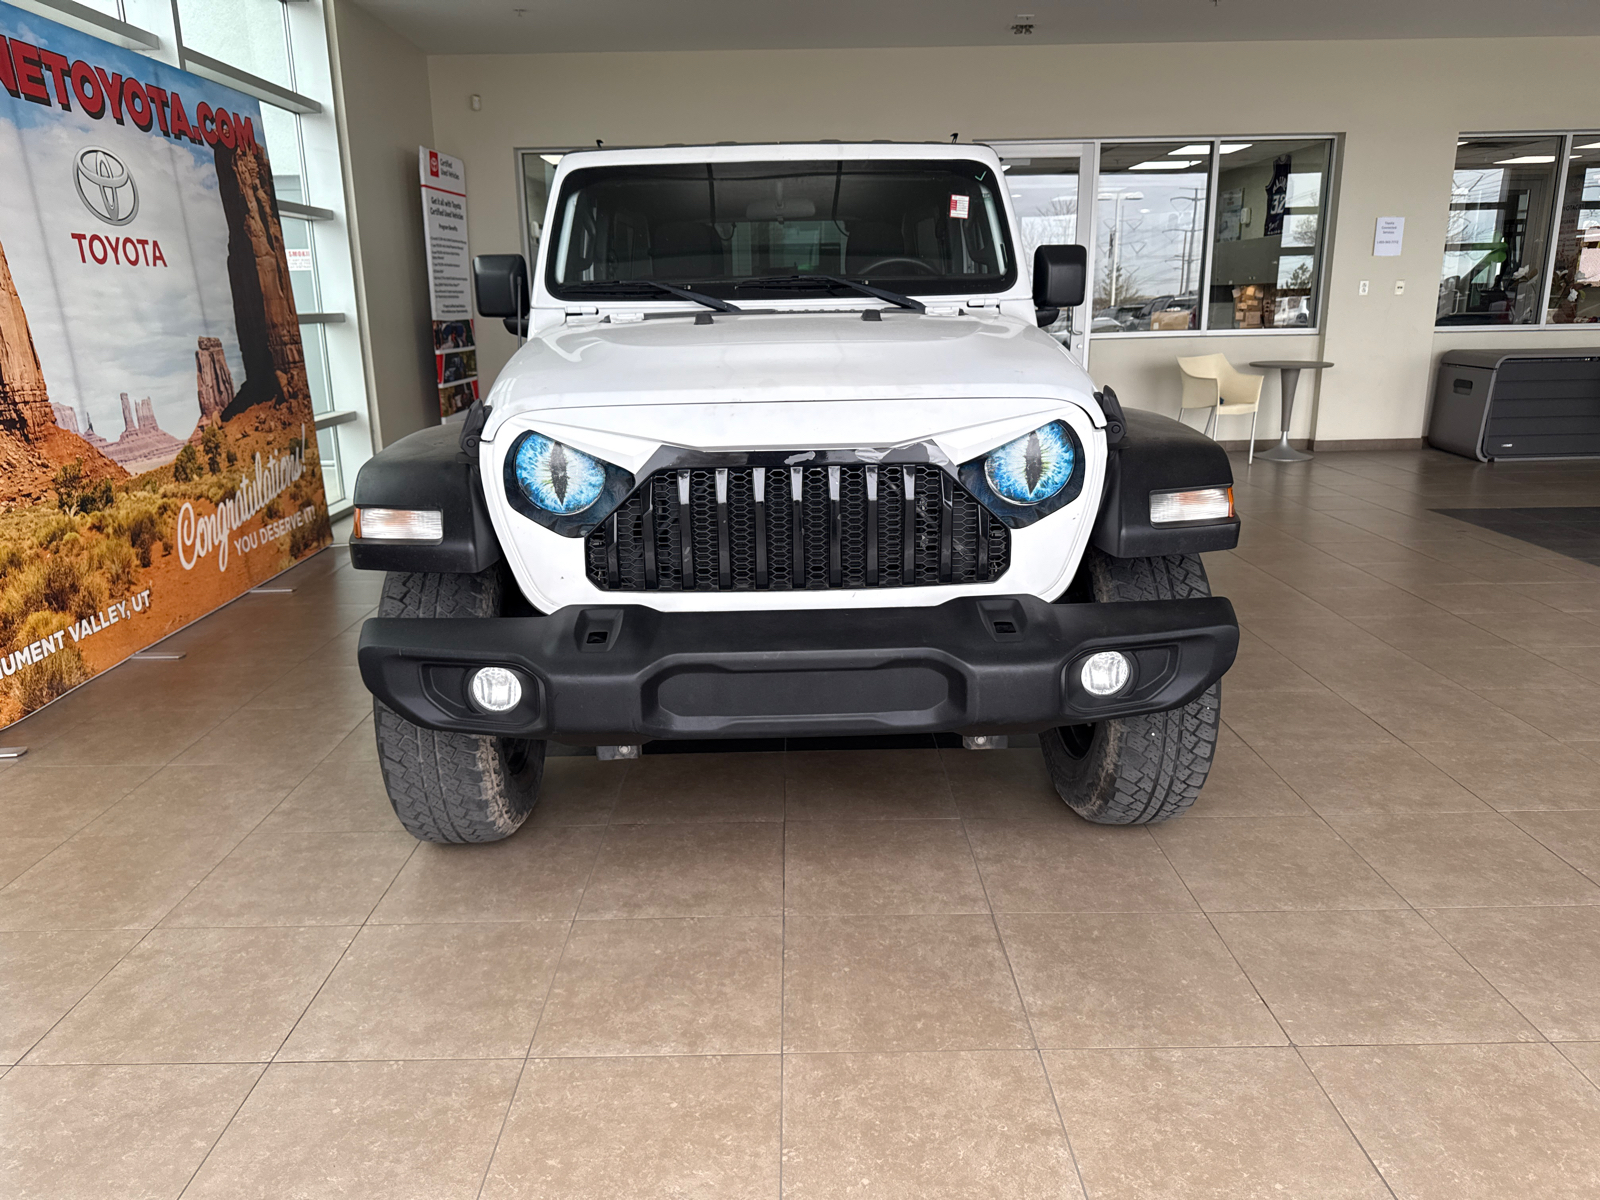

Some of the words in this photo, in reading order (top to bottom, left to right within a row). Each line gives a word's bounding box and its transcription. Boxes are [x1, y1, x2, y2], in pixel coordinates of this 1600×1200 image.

[71, 233, 168, 267] TOYOTA
[177, 423, 307, 572] Congratulations!
[234, 532, 258, 556] YOU
[259, 511, 303, 545] DESERVE
[303, 505, 317, 524] IT!
[68, 600, 131, 643] VALLEY,
[131, 589, 150, 612] UT
